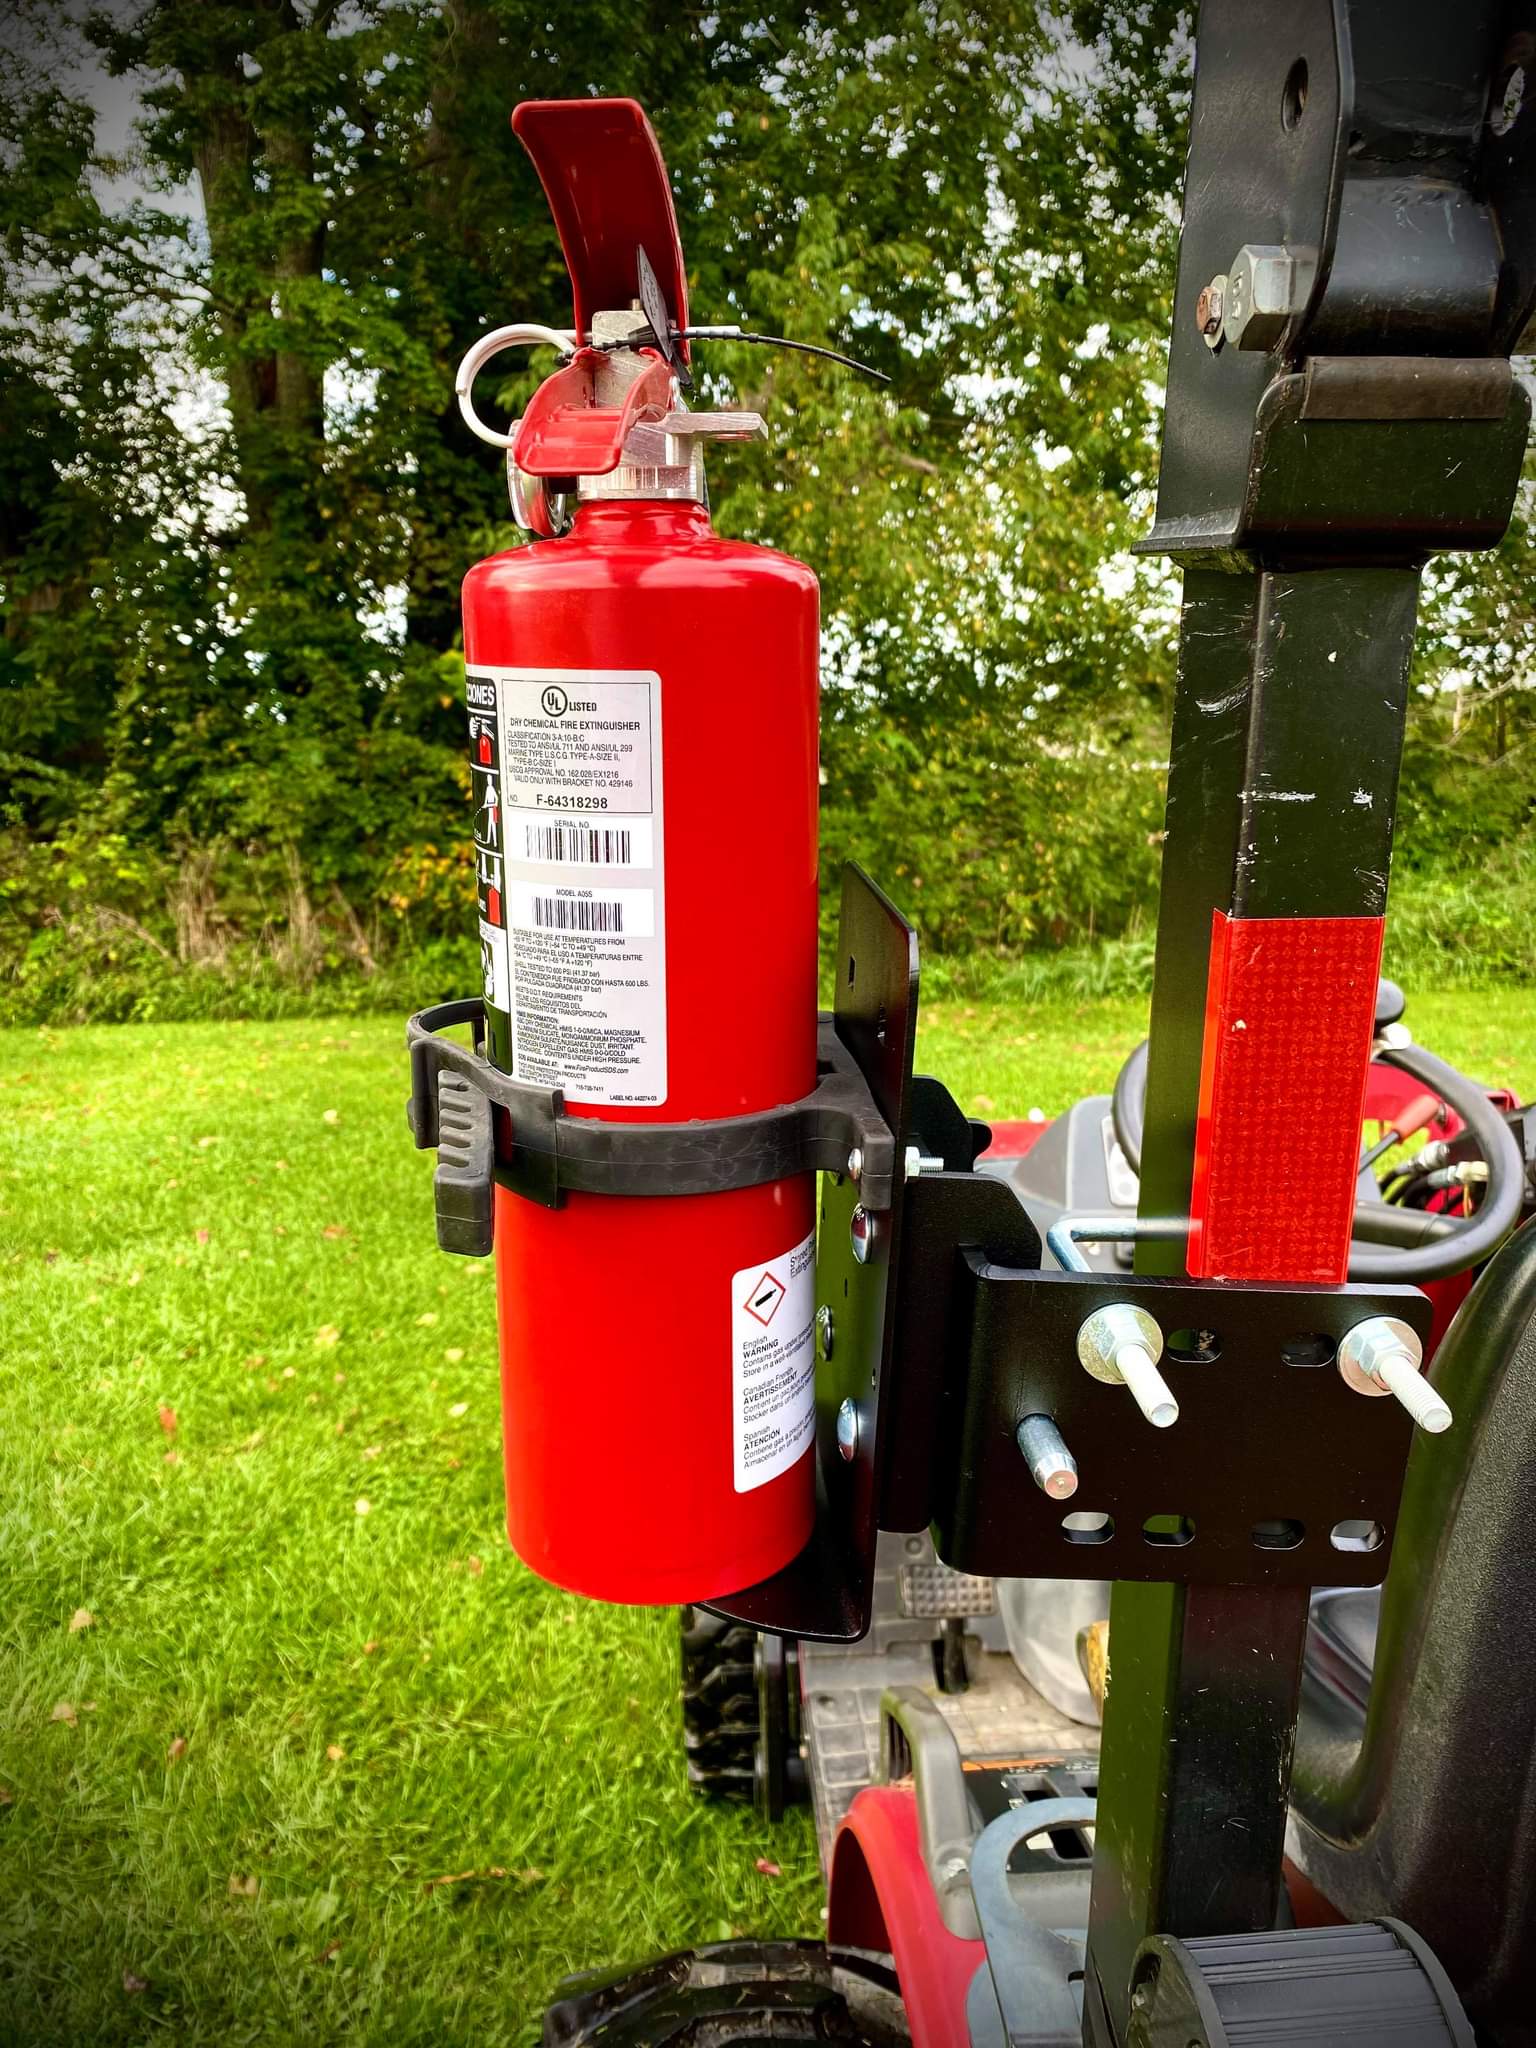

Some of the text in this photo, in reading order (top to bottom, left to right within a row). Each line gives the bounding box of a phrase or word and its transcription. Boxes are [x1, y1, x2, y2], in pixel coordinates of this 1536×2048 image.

[547, 692, 597, 712] UL LISTED
[510, 717, 640, 731] DRY CHEMICAL FIRE EXTINGUISHER
[508, 730, 551, 741] CLASSIFICATION
[508, 739, 528, 749] TESTED
[528, 740, 537, 749] TO
[562, 742, 573, 750] 711
[574, 743, 590, 752] AND
[591, 743, 619, 752] ANSI/UL
[620, 744, 633, 752] 299
[508, 748, 528, 757] MARINE
[528, 749, 543, 758] TYPE
[524, 767, 554, 776] APPROVAL
[514, 774, 528, 783] VALID
[530, 775, 544, 784] ONLY
[545, 776, 561, 785] WITH
[562, 777, 593, 787] BRACKET
[608, 779, 633, 788] 429146
[536, 793, 608, 809] F-64318298
[554, 820, 576, 828] SERIAL
[556, 888, 576, 897] MODEL
[532, 931, 543, 939] FOR
[562, 935, 606, 946] TEMPERATURES
[607, 938, 625, 946] FROM
[550, 949, 557, 957] EL
[557, 950, 569, 958] USO
[575, 951, 621, 961] TEMPERATURAS
[527, 962, 545, 972] TESTED
[520, 968, 551, 980] CONTENEDOR
[551, 974, 562, 983] FUE
[562, 976, 590, 985] PROBADO
[590, 978, 604, 987] CON
[604, 979, 624, 987] HASTA
[524, 977, 545, 987] PULGADA
[545, 981, 573, 991] CUADRADA
[541, 990, 583, 1002] REQUIREMENTS
[540, 998, 569, 1009] REQUISITOS
[570, 1002, 581, 1010] DEL
[517, 1024, 538, 1034] ALUMINUM
[561, 1032, 609, 1042] MONOAMMONIUM
[517, 1030, 540, 1041] AMMONIUM
[534, 1020, 559, 1031] CHEMICAL
[604, 1029, 640, 1037] MAGNESIUM
[517, 1037, 539, 1048] NITROGEN
[539, 1041, 566, 1053] EXPELLENT
[567, 1046, 579, 1054] GAS
[526, 1055, 551, 1067] AVAILABLE
[544, 1049, 571, 1060] CONTENTS
[572, 1054, 591, 1062] UNDER
[592, 1055, 607, 1063] HIGH
[536, 1065, 562, 1077] PROTECTION
[562, 1070, 586, 1079] PRODUCTS
[743, 1335, 767, 1351] English
[743, 1338, 779, 1360] WARNING
[743, 1351, 772, 1369] Contains
[773, 1346, 784, 1359] gas
[743, 1366, 761, 1379] Store
[743, 1378, 774, 1396] Canadian
[775, 1366, 793, 1382] French
[744, 1370, 797, 1406] AVERTISSEMENT
[743, 1397, 771, 1415] Contient
[743, 1408, 769, 1424] Stocker
[770, 1400, 783, 1413] dans
[743, 1425, 770, 1442] Spanish
[743, 1442, 772, 1460] Contiene
[773, 1435, 784, 1448] gas
[743, 1448, 778, 1470] Almacenar
